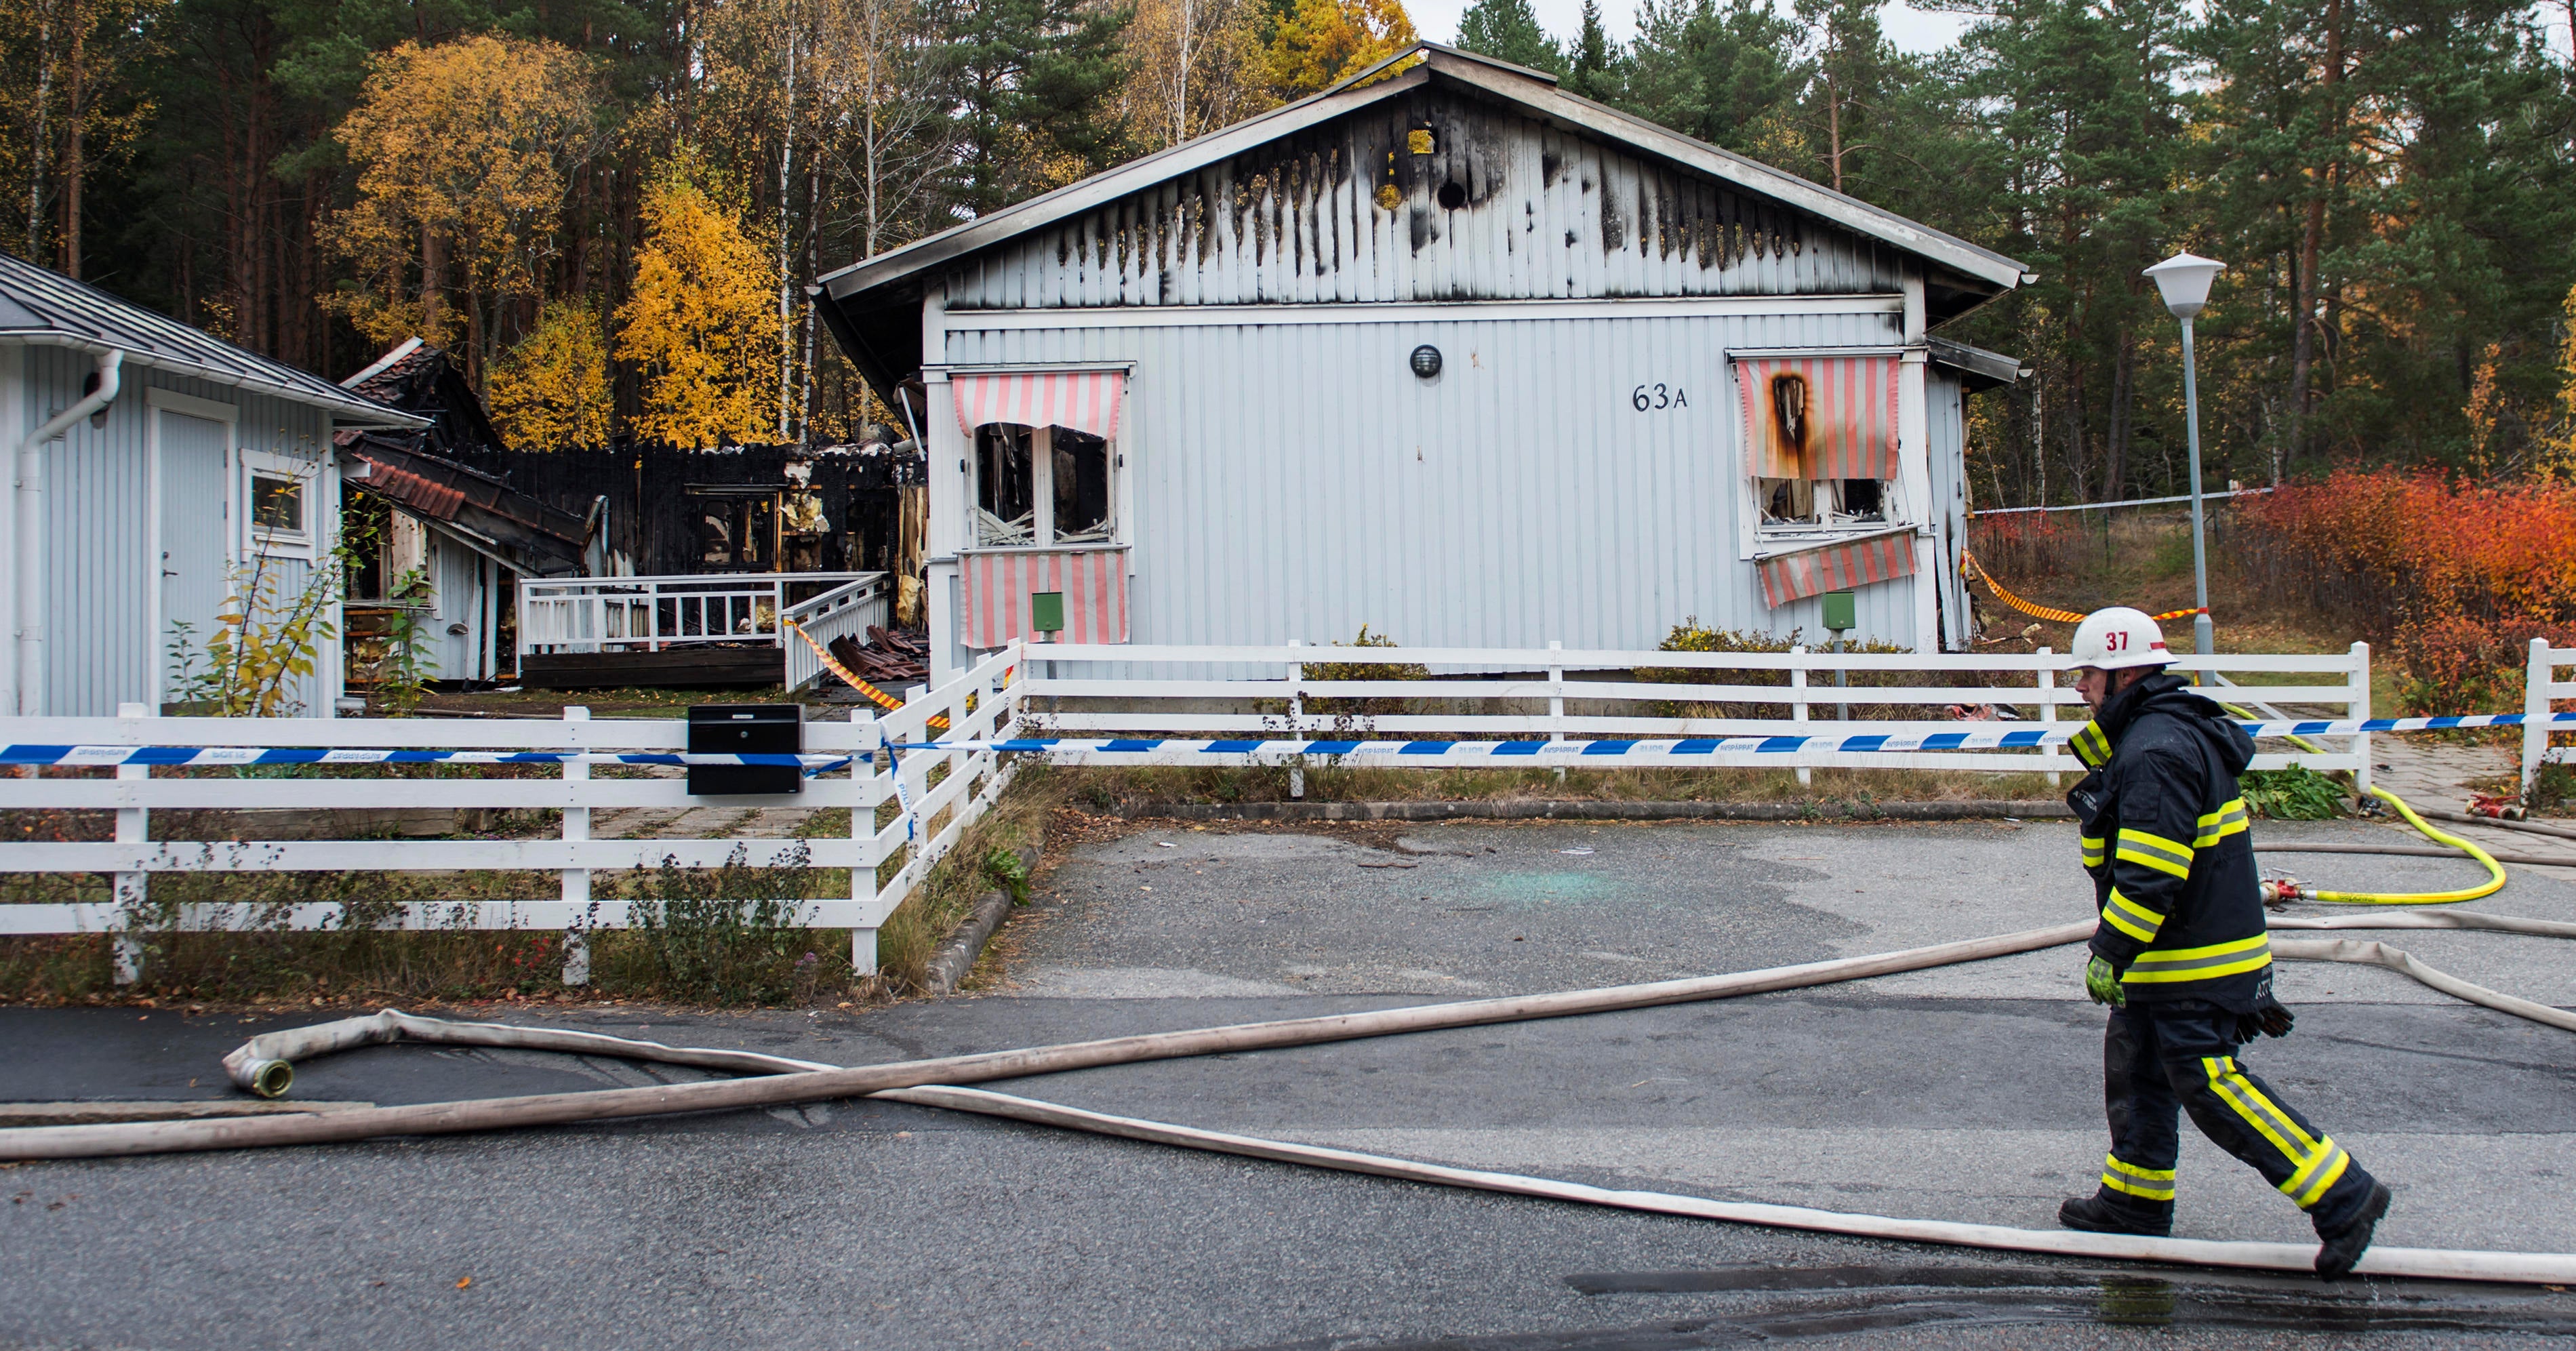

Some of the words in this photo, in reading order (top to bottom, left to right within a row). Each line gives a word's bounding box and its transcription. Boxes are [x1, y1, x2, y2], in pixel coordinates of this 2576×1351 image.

[1632, 382, 1687, 412] 63A
[2106, 631, 2129, 651] 37
[2091, 959, 2111, 982] 37
